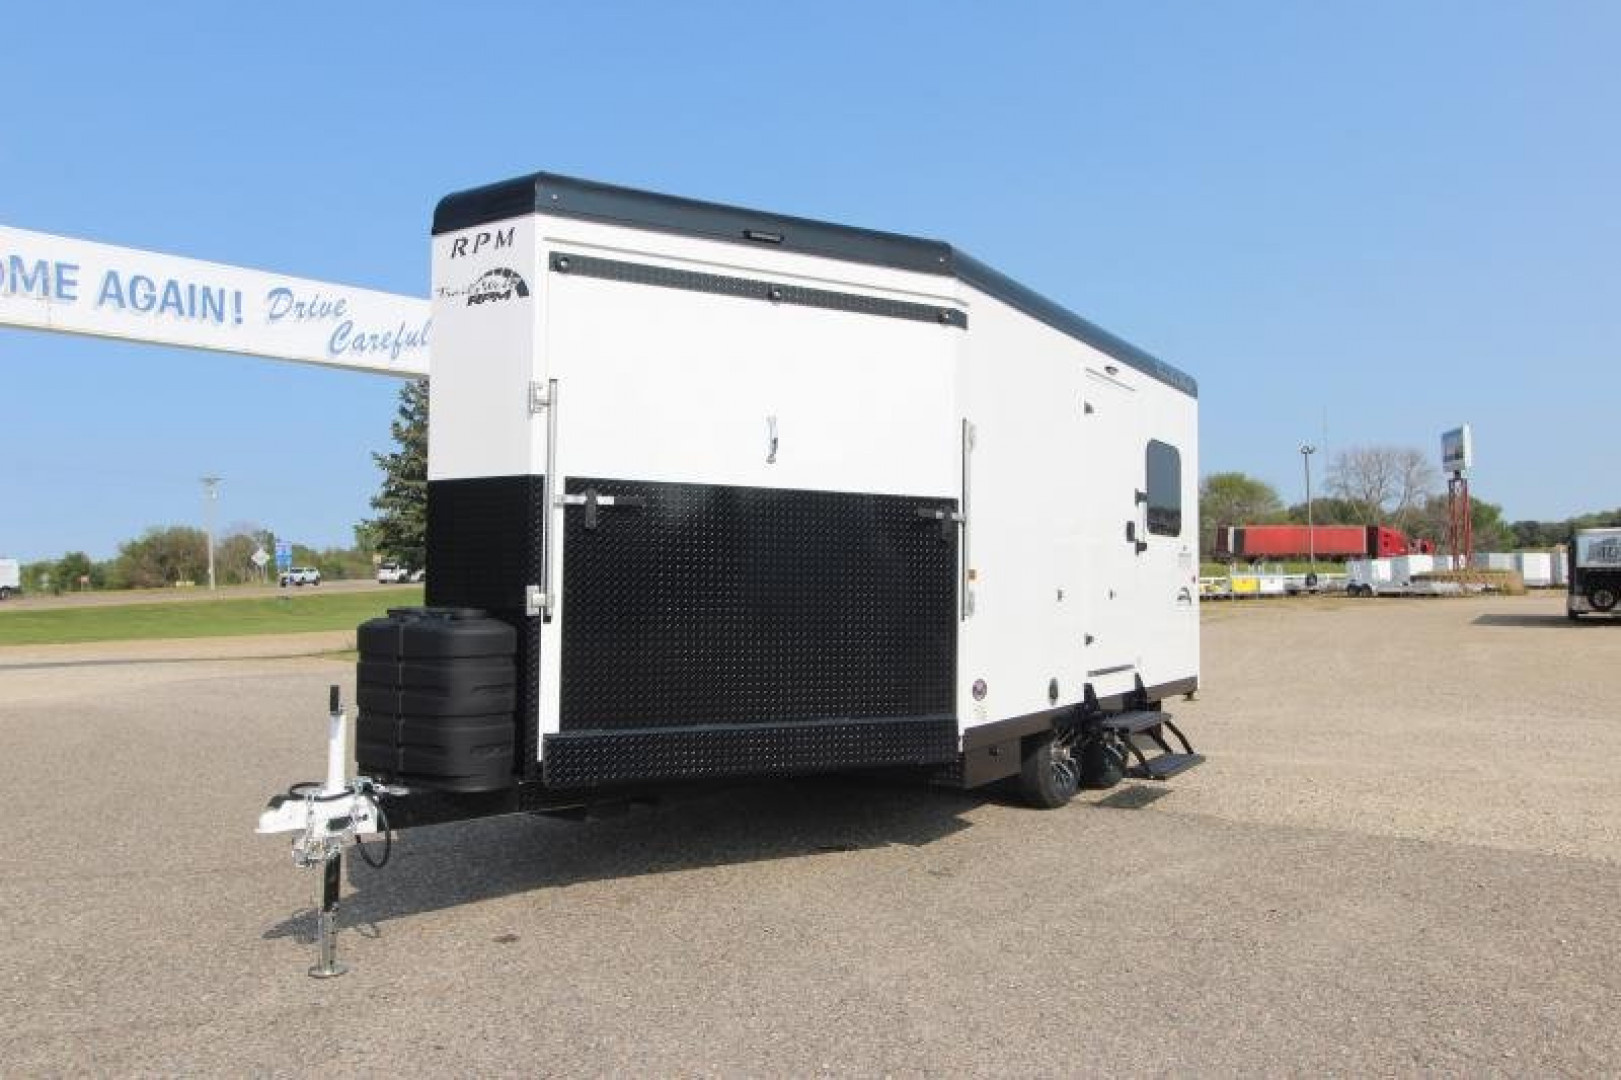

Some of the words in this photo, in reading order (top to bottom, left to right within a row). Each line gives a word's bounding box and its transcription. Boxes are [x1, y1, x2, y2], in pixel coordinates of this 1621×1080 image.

[451, 227, 515, 258] RPM
[0, 254, 79, 300] ME
[98, 270, 243, 325] AGAIN!
[267, 287, 347, 321] Drive
